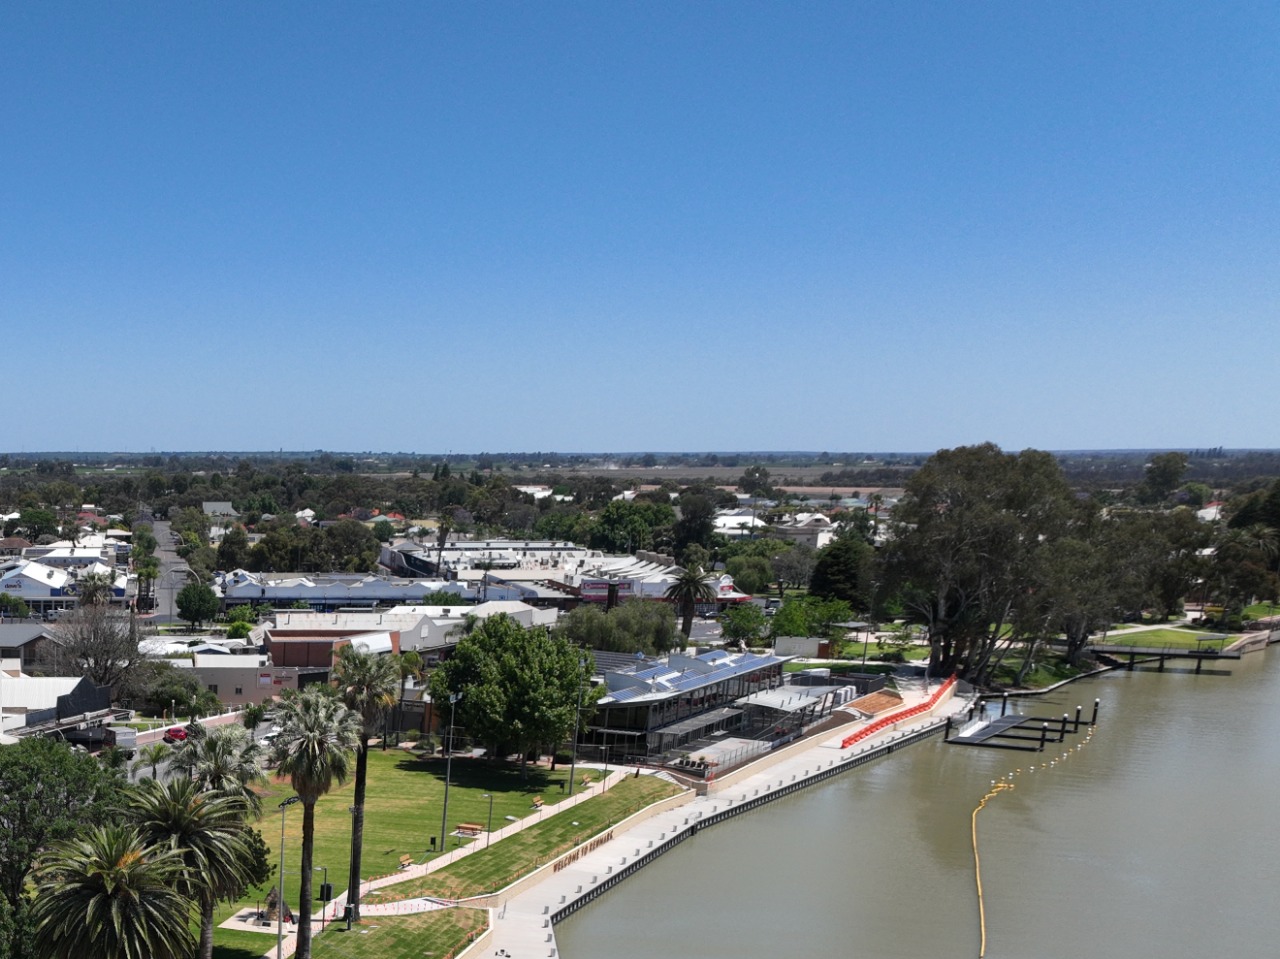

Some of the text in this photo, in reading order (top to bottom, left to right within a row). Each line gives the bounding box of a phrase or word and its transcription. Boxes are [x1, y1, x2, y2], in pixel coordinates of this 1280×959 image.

[553, 830, 613, 872] WELCOME TO RENMARK
